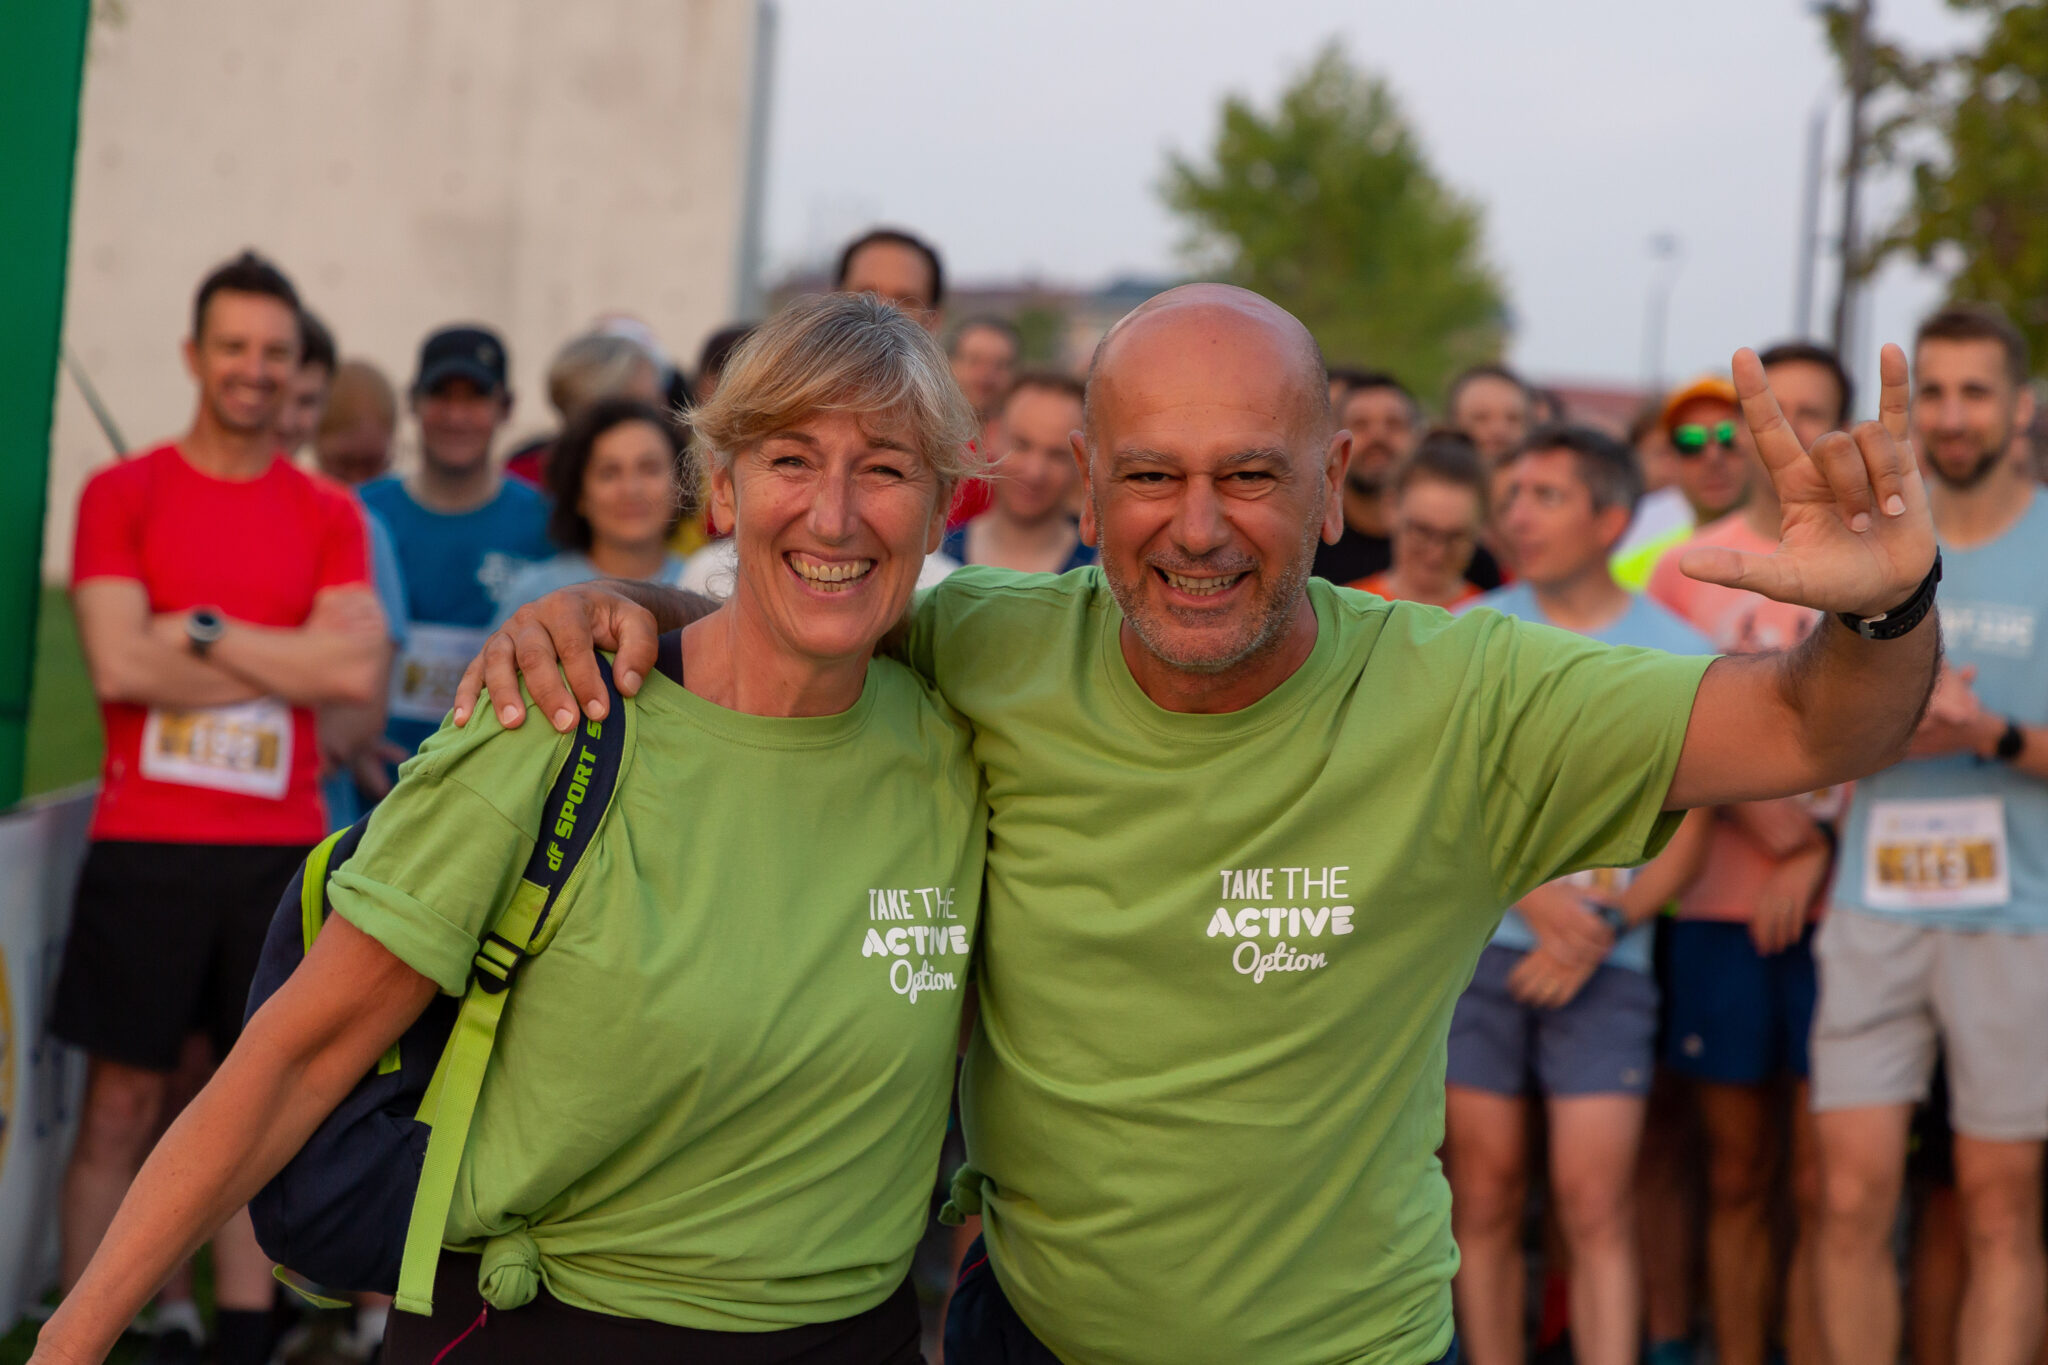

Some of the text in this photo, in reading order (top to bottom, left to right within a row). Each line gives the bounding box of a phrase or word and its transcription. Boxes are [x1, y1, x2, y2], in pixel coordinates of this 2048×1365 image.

[554, 745, 597, 840] SPORT
[586, 719, 602, 740] S
[1220, 866, 1350, 900] TAKE THE
[868, 887, 958, 920] TAKE THE
[1206, 905, 1355, 938] ACTIVE
[861, 925, 970, 958] ACTIVE
[1232, 940, 1328, 984] Option
[889, 959, 957, 1005] Option
